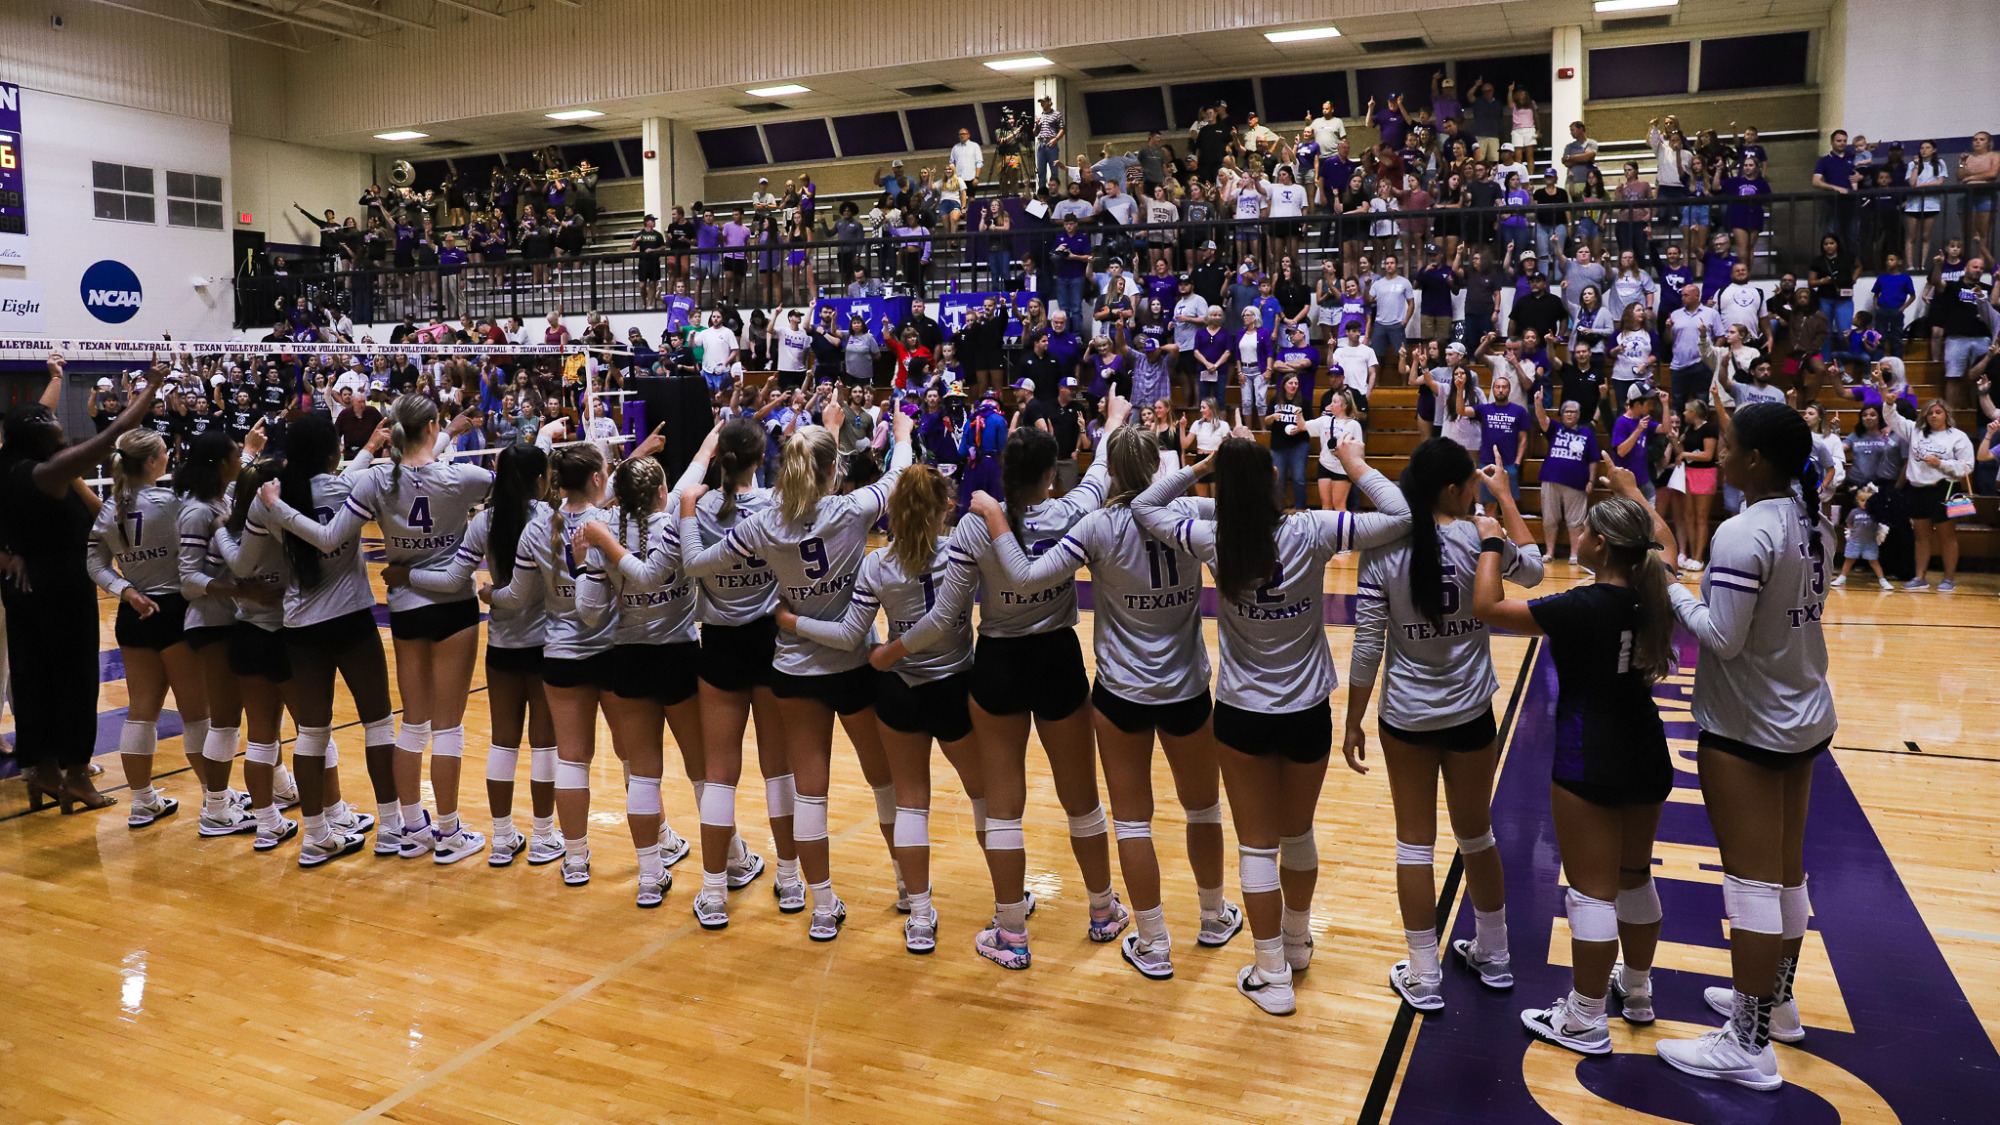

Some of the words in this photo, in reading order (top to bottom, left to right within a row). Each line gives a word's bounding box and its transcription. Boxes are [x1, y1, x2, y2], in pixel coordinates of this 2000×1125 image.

[88, 289, 142, 307] NCAA
[2, 299, 40, 316] Eight
[79, 341, 111, 351] TEXAN
[114, 342, 172, 351] VOLLEYBALL
[193, 343, 222, 352] TEXAN
[224, 344, 273, 352] VOLLEYBALL
[318, 345, 360, 353] VOLLEYBALL
[378, 345, 399, 353] TEXAN
[1280, 414, 1297, 423] TATE
[1487, 414, 1515, 422] TARLETON
[1550, 447, 1584, 461] GIRLS
[407, 495, 434, 534] 4
[391, 534, 455, 550] TEXANS
[116, 546, 168, 563] TEXANS
[798, 536, 830, 580] 9
[1145, 539, 1180, 590] 11
[715, 569, 776, 588] TEXAN
[788, 573, 852, 601] TEXANS
[1123, 585, 1196, 611] TEXANS
[1236, 597, 1312, 622] TEXANS
[1402, 617, 1484, 641] TEXANS
